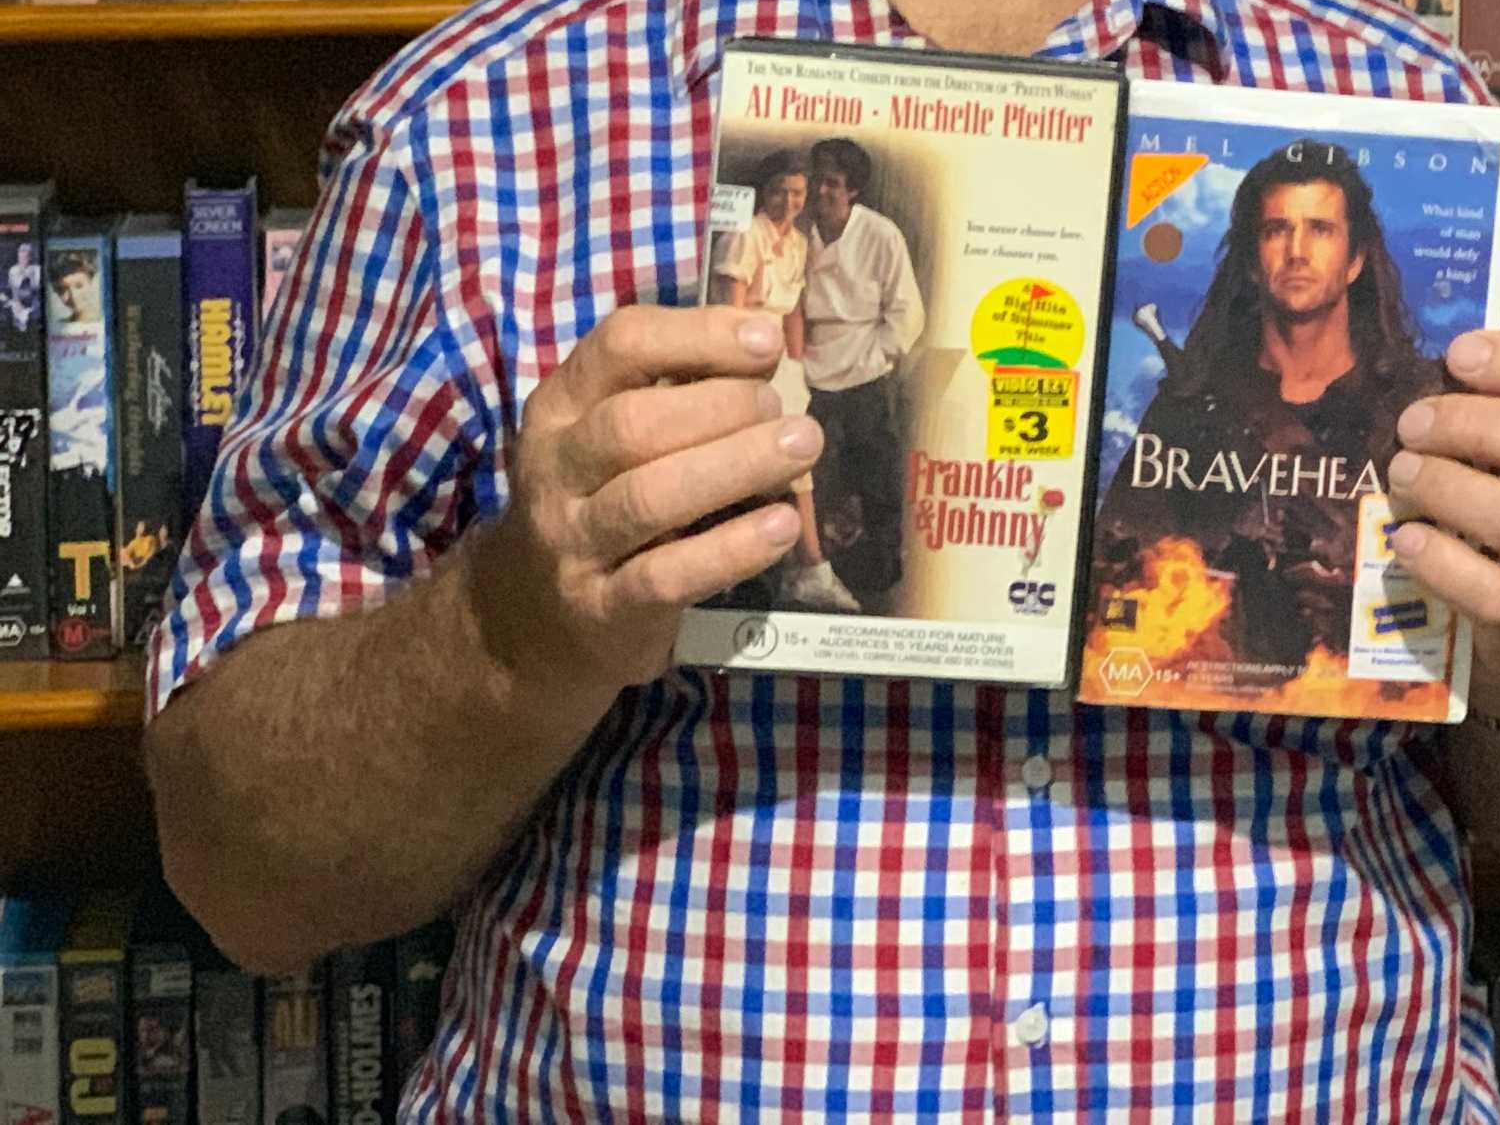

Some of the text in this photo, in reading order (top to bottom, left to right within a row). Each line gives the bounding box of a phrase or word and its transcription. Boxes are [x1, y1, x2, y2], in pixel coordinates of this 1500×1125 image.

[746, 84, 1093, 144] Al Pacino Michelle Pfeiffer
[200, 297, 234, 427] HAMLET
[907, 450, 1034, 507] Frankie
[1130, 432, 1385, 500] BRAVEHEA
[1107, 662, 1145, 682] MA
